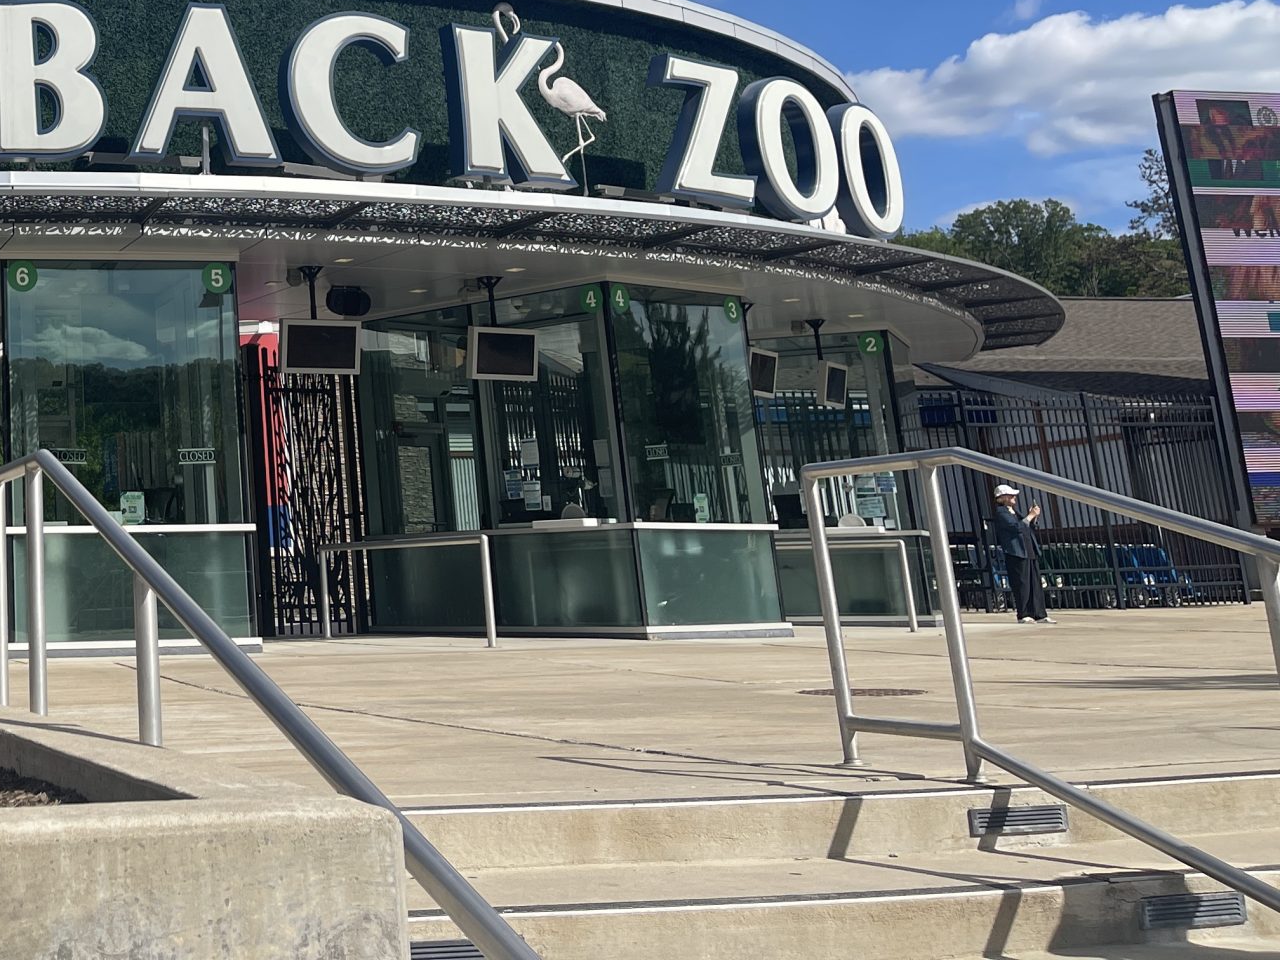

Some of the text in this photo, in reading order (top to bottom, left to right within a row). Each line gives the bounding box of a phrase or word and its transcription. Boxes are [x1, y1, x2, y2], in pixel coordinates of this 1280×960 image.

[663, 53, 905, 237] ZOO
[15, 267, 30, 286] 6
[211, 268, 224, 288] 5
[585, 290, 597, 308] 4
[615, 289, 625, 307] 4
[729, 302, 737, 319] 3
[865, 337, 877, 352] 2
[179, 450, 215, 462] CLOSED
[646, 447, 668, 458] CLOSED
